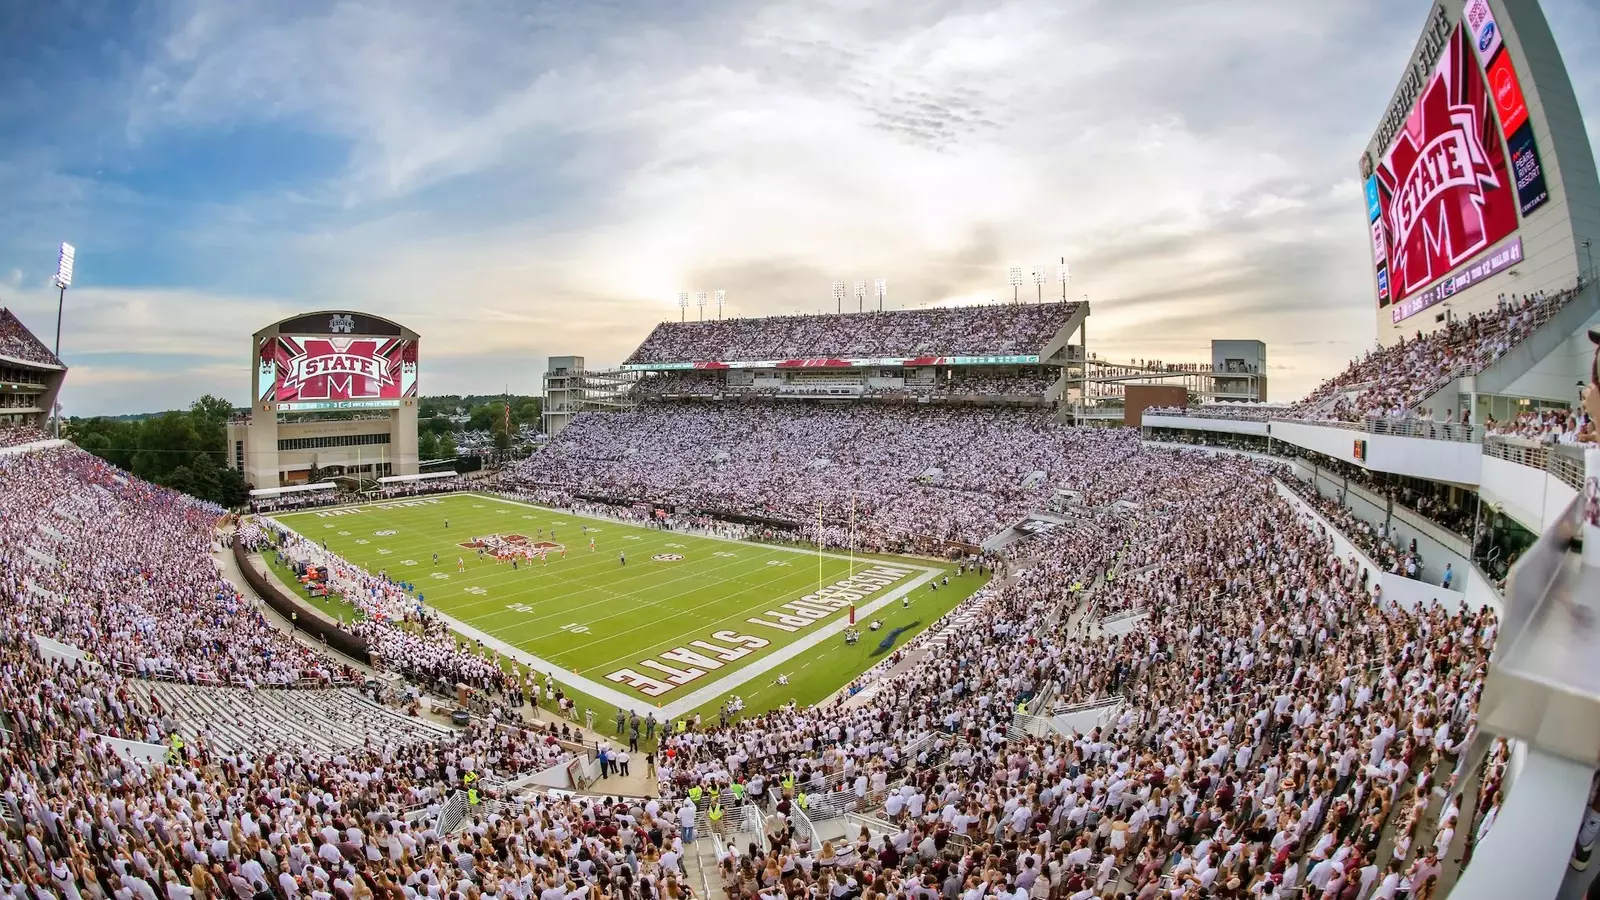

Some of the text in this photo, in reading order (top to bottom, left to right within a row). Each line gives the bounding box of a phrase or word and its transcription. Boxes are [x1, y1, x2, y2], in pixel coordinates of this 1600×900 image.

[1418, 4, 1452, 77] STATE
[1515, 150, 1534, 170] PEARL
[1518, 158, 1535, 178] RIVER
[1401, 136, 1465, 228] STATE
[1518, 165, 1540, 190] RESORT
[305, 356, 373, 375] STATE
[746, 564, 915, 633] MISSISSIPPI
[560, 622, 589, 634] 10
[603, 629, 771, 698] STATE
